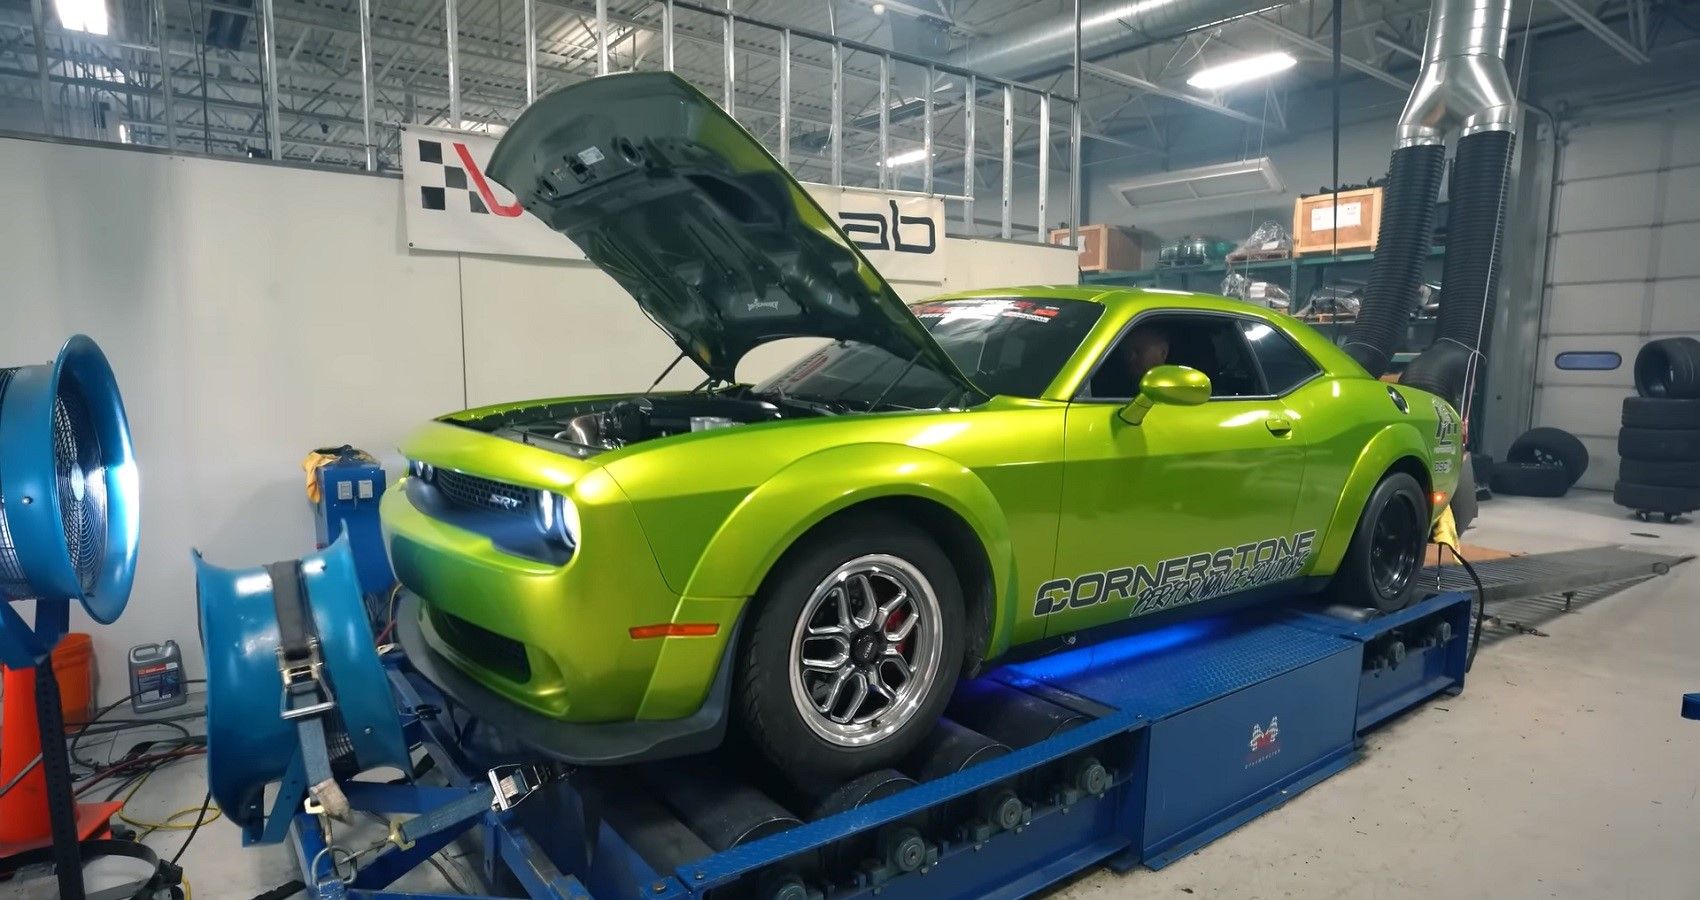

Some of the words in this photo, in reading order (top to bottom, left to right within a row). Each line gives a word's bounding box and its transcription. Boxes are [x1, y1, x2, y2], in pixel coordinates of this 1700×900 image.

[490, 494, 522, 510] SRT
[1033, 529, 1317, 617] CORNERSTONE
[1129, 565, 1250, 617] PERFORMANCE
